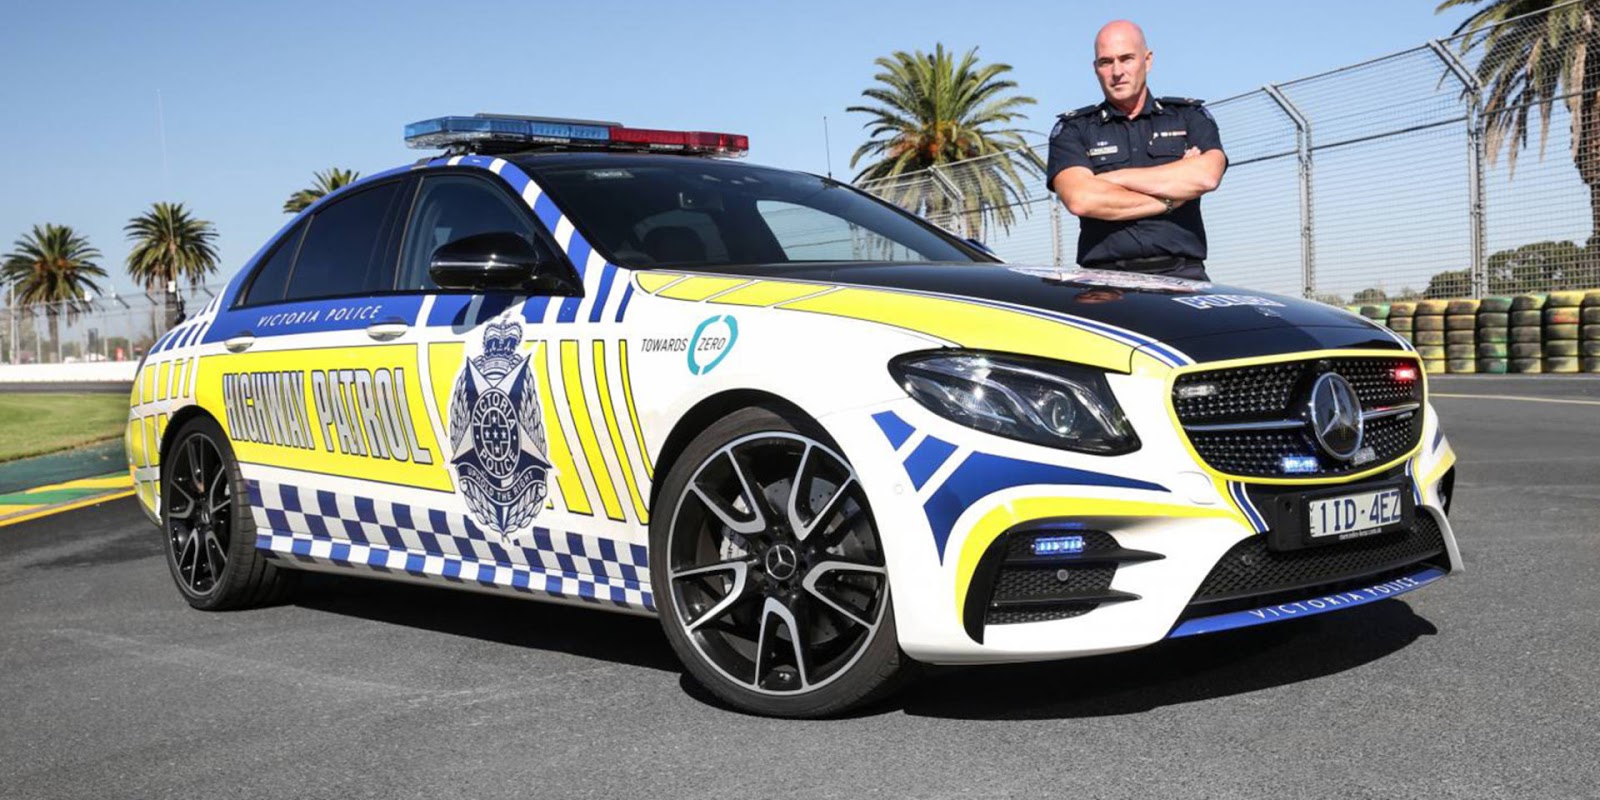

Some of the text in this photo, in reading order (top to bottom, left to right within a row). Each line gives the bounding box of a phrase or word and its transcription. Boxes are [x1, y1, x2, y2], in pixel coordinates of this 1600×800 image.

[257, 305, 382, 328] VICTORIA POLICE
[641, 337, 726, 352] TOWARDS ZERO
[223, 367, 433, 465] HIGHWAY PATROL
[474, 393, 516, 430] VICTORIA
[480, 448, 517, 475] POLICE
[497, 490, 512, 501] THE
[512, 470, 534, 496] RIGHT
[1249, 577, 1419, 619] VICTORIA POLICE
